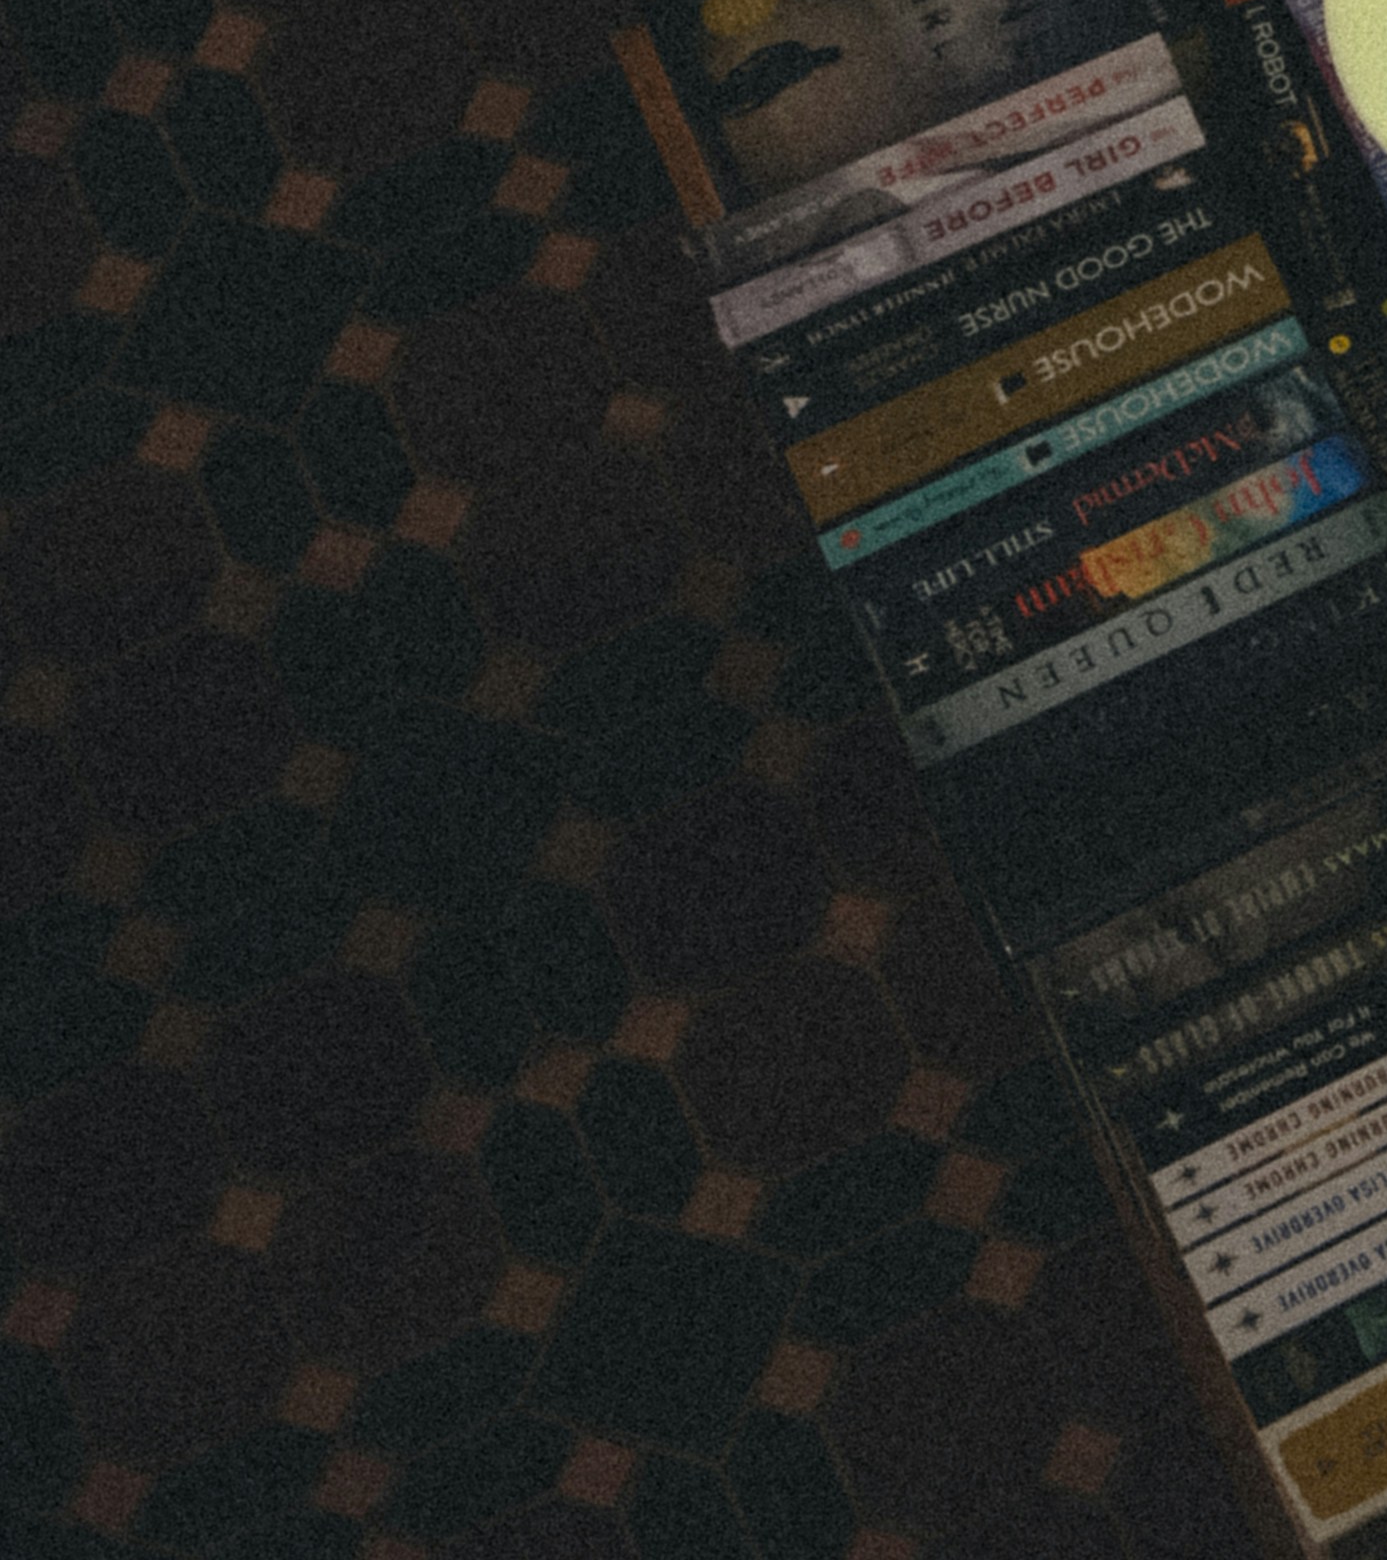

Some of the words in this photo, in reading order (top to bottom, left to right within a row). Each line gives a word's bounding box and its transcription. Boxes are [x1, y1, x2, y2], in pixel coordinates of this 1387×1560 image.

[1248, 23, 1300, 111] ROBOT
[1062, 133, 1142, 182] GIRL
[920, 169, 1056, 242] BEFORE
[1156, 202, 1212, 246] THE
[1051, 228, 1156, 294] GOOD
[954, 275, 1051, 338] NURSE
[1029, 258, 1265, 384] WODEHOUSE
[1054, 323, 1293, 452] WODEHOUSE
[973, 517, 1053, 571] STILL
[1229, 532, 1325, 598] RED
[908, 555, 973, 602] LIFE
[990, 603, 1175, 710] QUEEN
[1223, 1109, 1302, 1163] CHROME
[1241, 1148, 1319, 1202] CHROME
[1346, 1169, 1387, 1205] LISA
[1248, 1191, 1345, 1254] OVERDRIVE
[1274, 1249, 1371, 1313] OVERDRIVE
